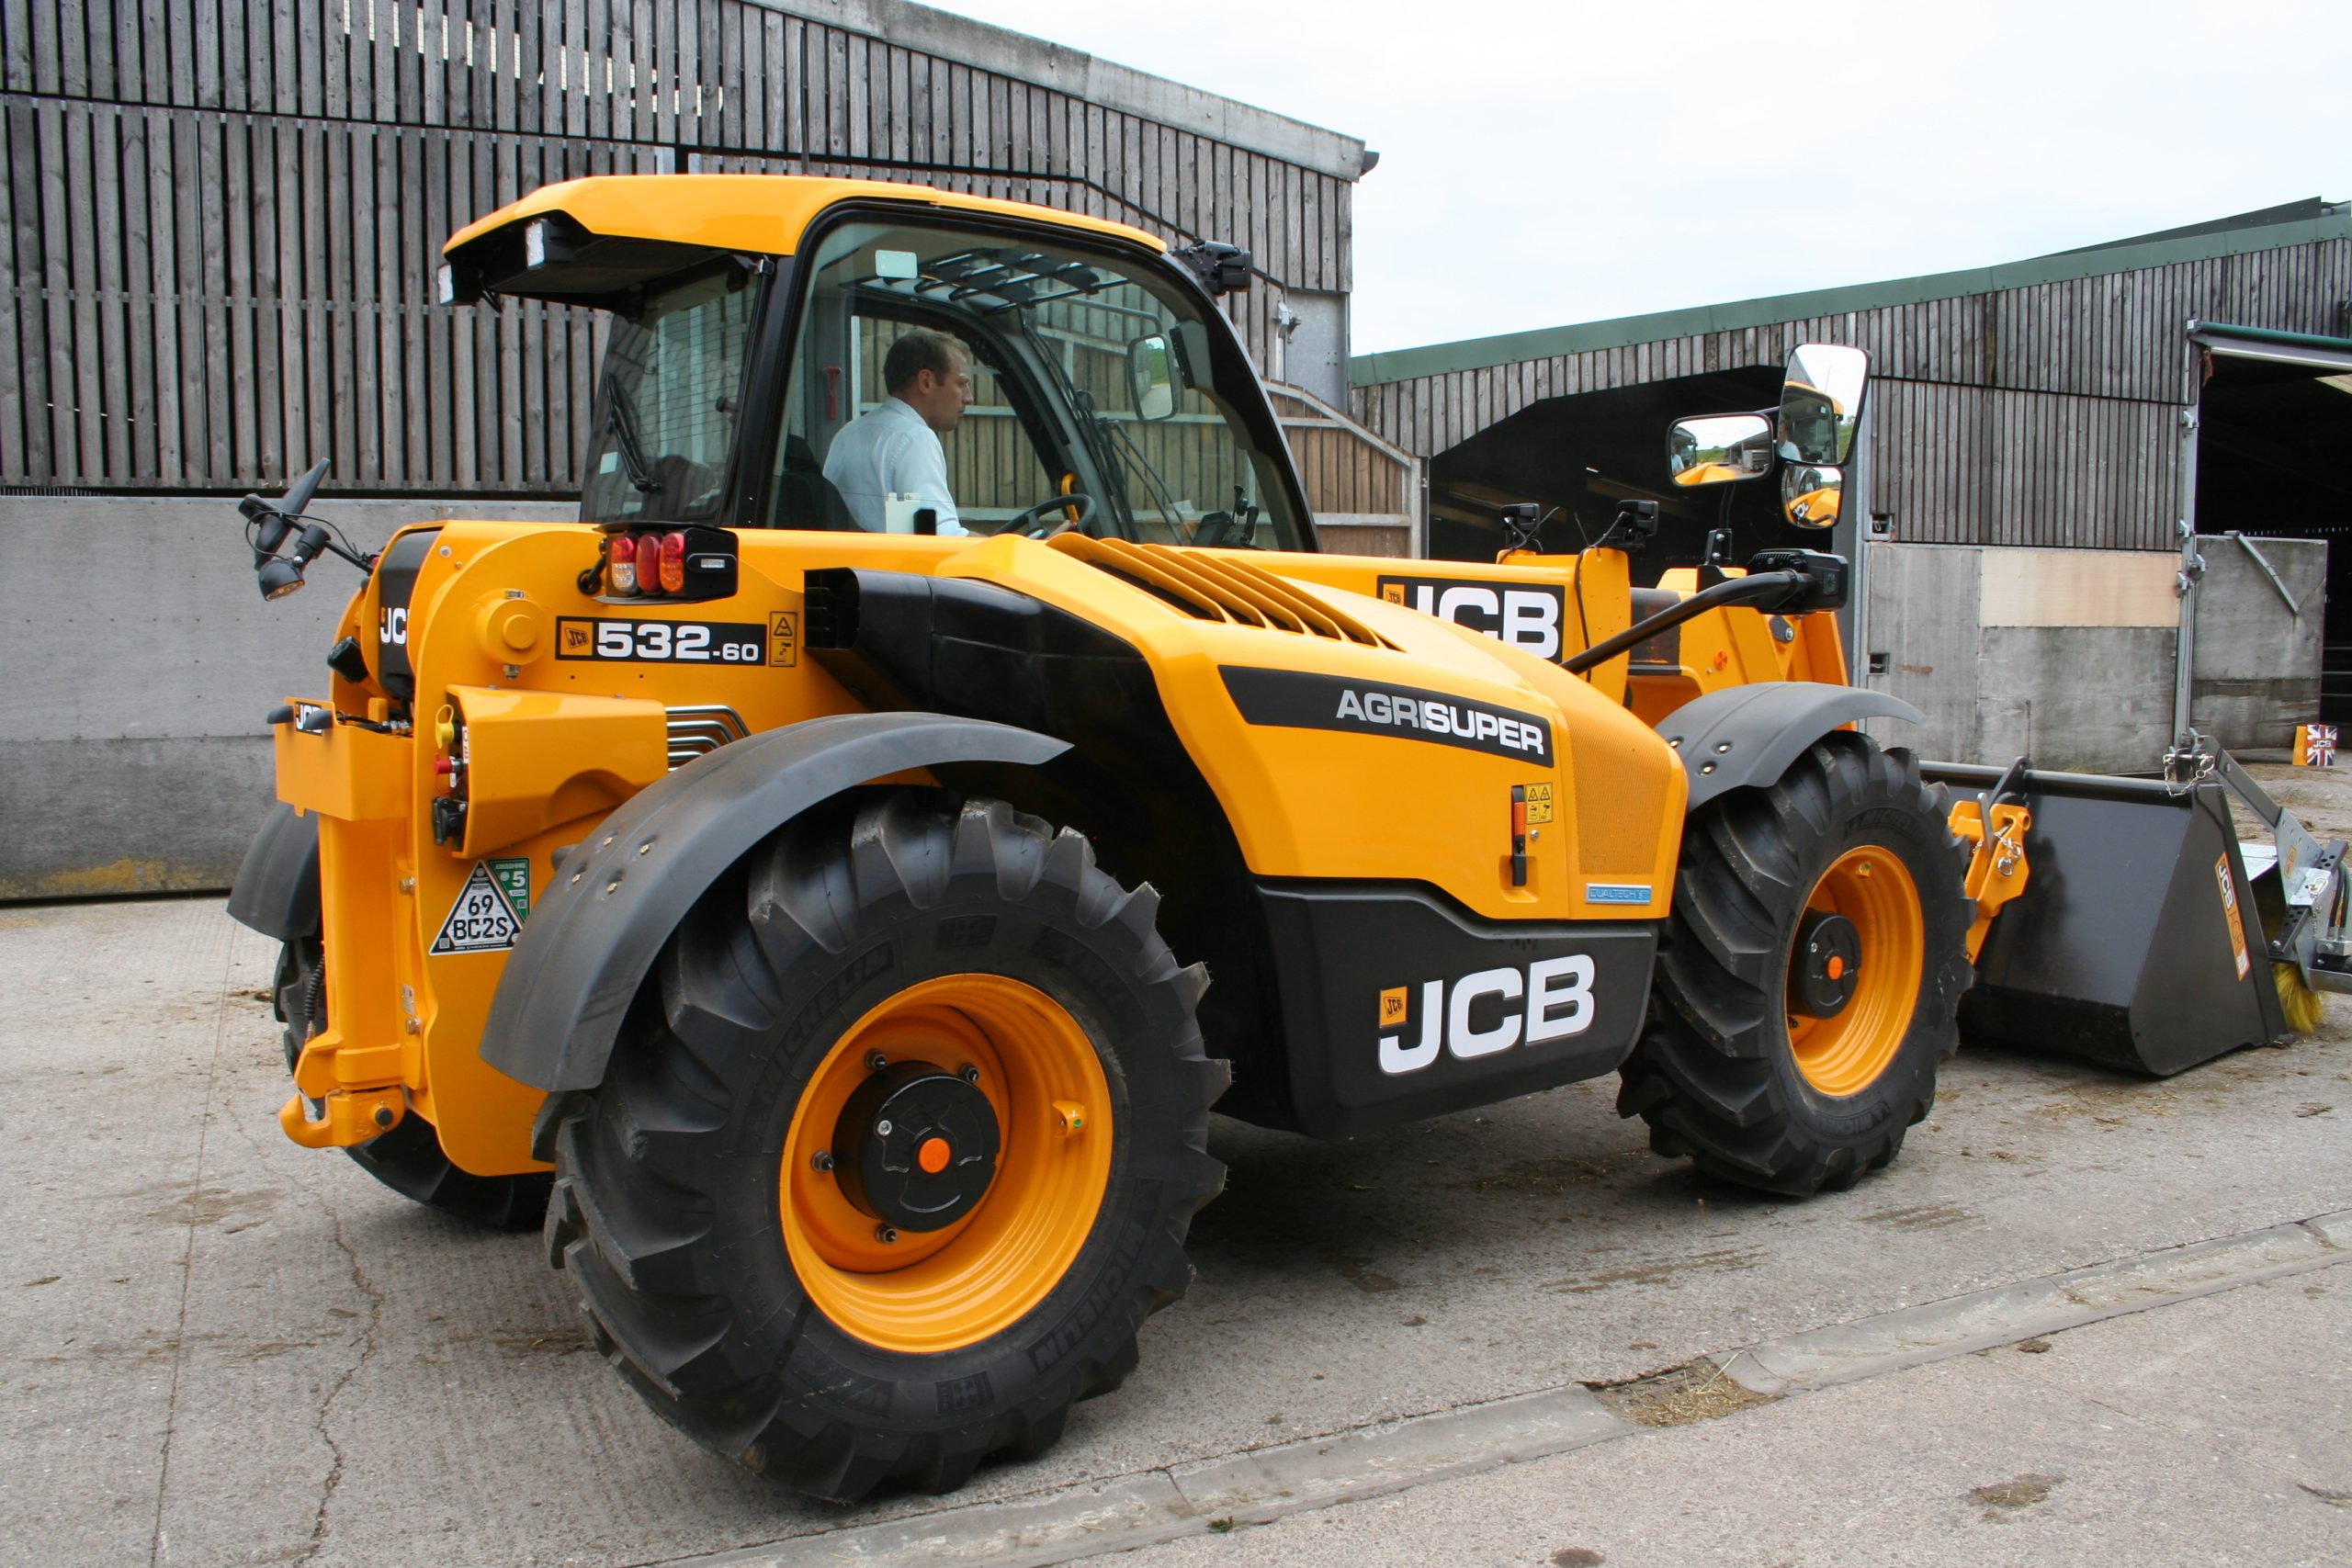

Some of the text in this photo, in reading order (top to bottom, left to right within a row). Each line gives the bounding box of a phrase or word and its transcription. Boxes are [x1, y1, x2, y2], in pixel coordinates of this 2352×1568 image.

[379, 607, 410, 644] JC
[569, 629, 588, 646] JCB
[597, 622, 759, 661] 532-60
[1336, 689, 1544, 755] AGRISUPER
[2312, 739, 2331, 748] JCB
[512, 870, 526, 887] 5
[2218, 865, 2234, 910] JCB
[468, 894, 493, 916] 69
[453, 917, 508, 941] BC2S
[1379, 953, 1595, 1074] JCB
[1387, 998, 1402, 1015] JCB
